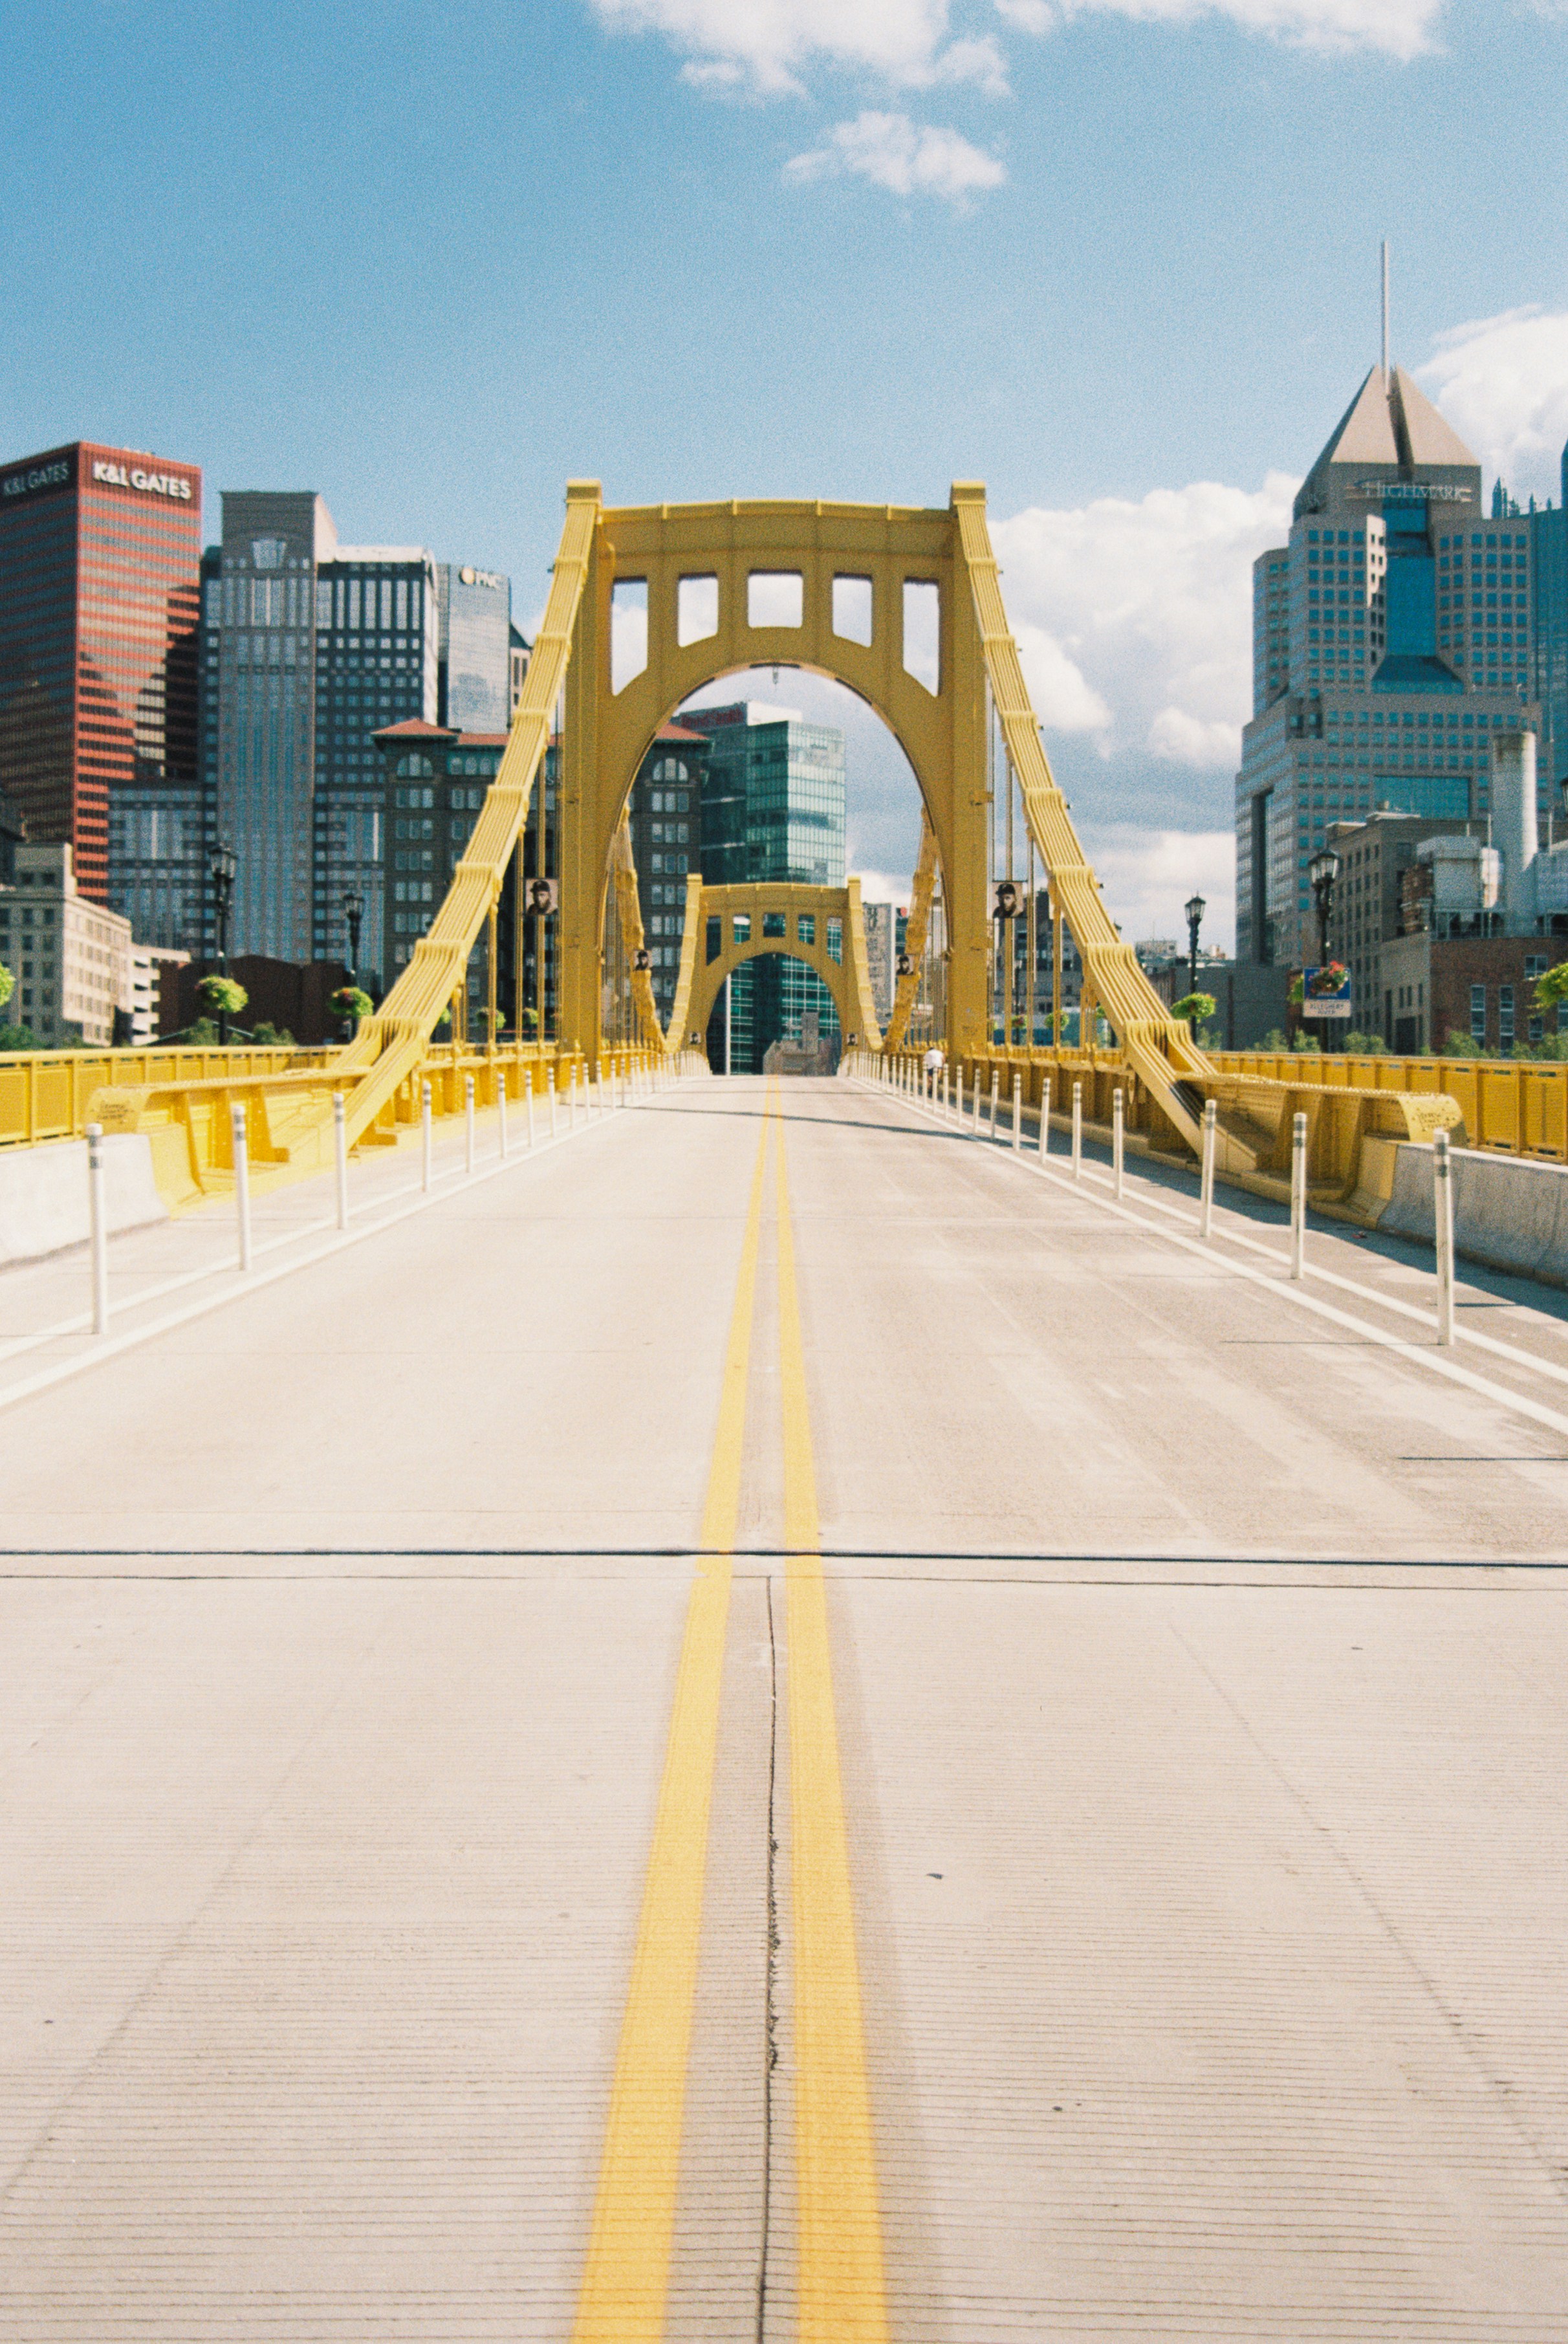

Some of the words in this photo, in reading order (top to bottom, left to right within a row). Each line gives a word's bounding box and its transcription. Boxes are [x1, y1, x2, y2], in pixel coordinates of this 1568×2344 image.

[28, 461, 69, 489] GATES
[93, 461, 130, 487] K&L
[131, 470, 192, 499] GATES
[476, 571, 502, 590] PNC
